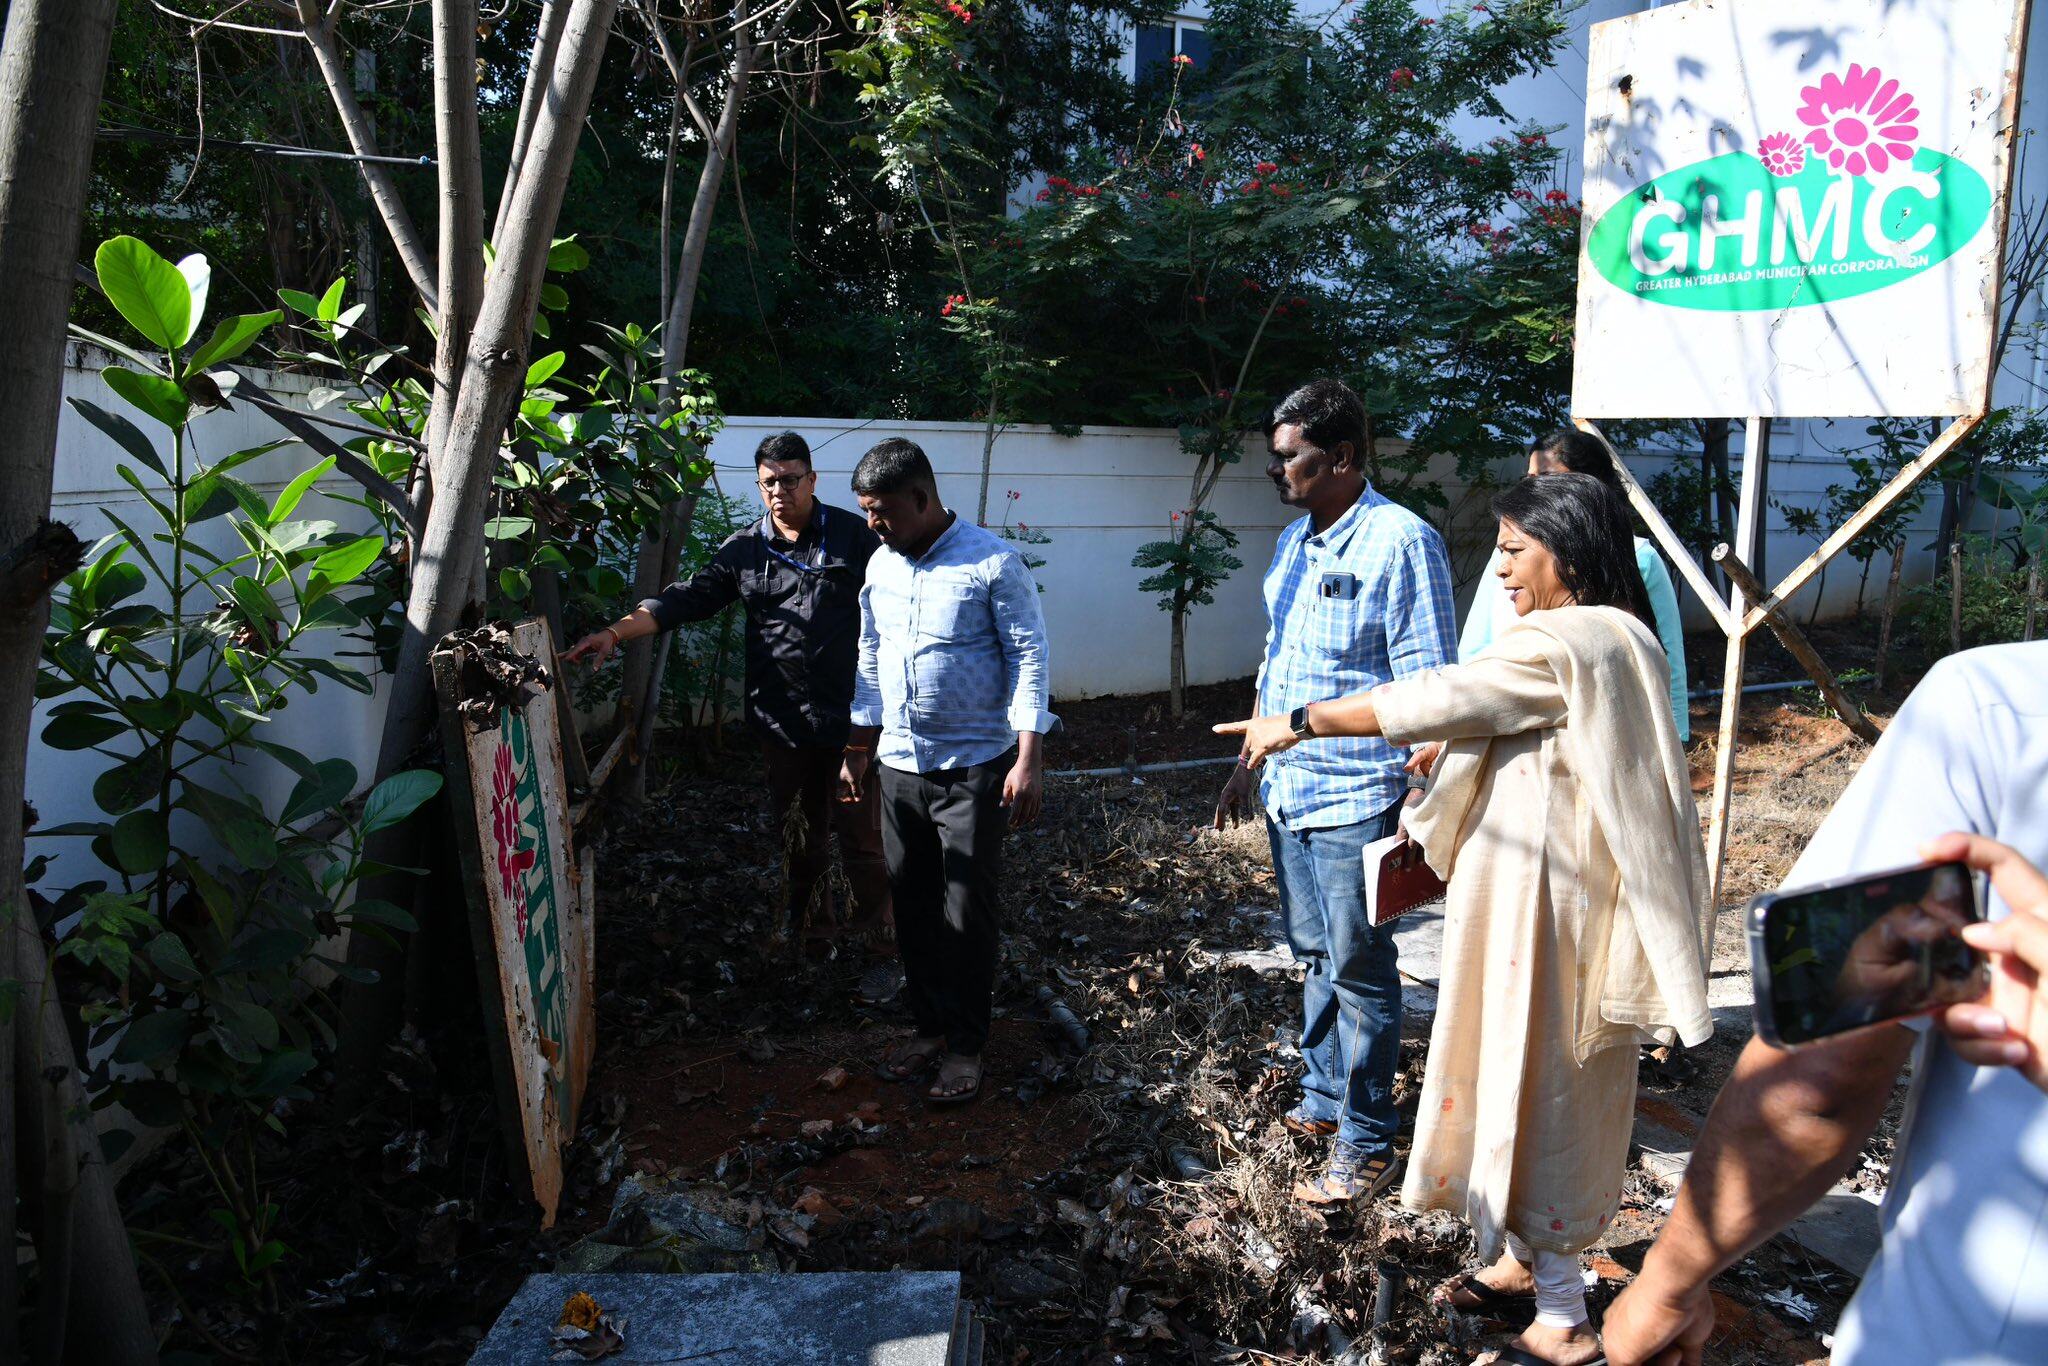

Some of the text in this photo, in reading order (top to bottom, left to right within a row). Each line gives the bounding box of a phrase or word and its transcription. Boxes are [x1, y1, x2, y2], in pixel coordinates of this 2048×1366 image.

[1628, 173, 1940, 276] GHMC
[1636, 276, 1682, 292] GREATER
[1685, 270, 1753, 288] HYDERABAD
